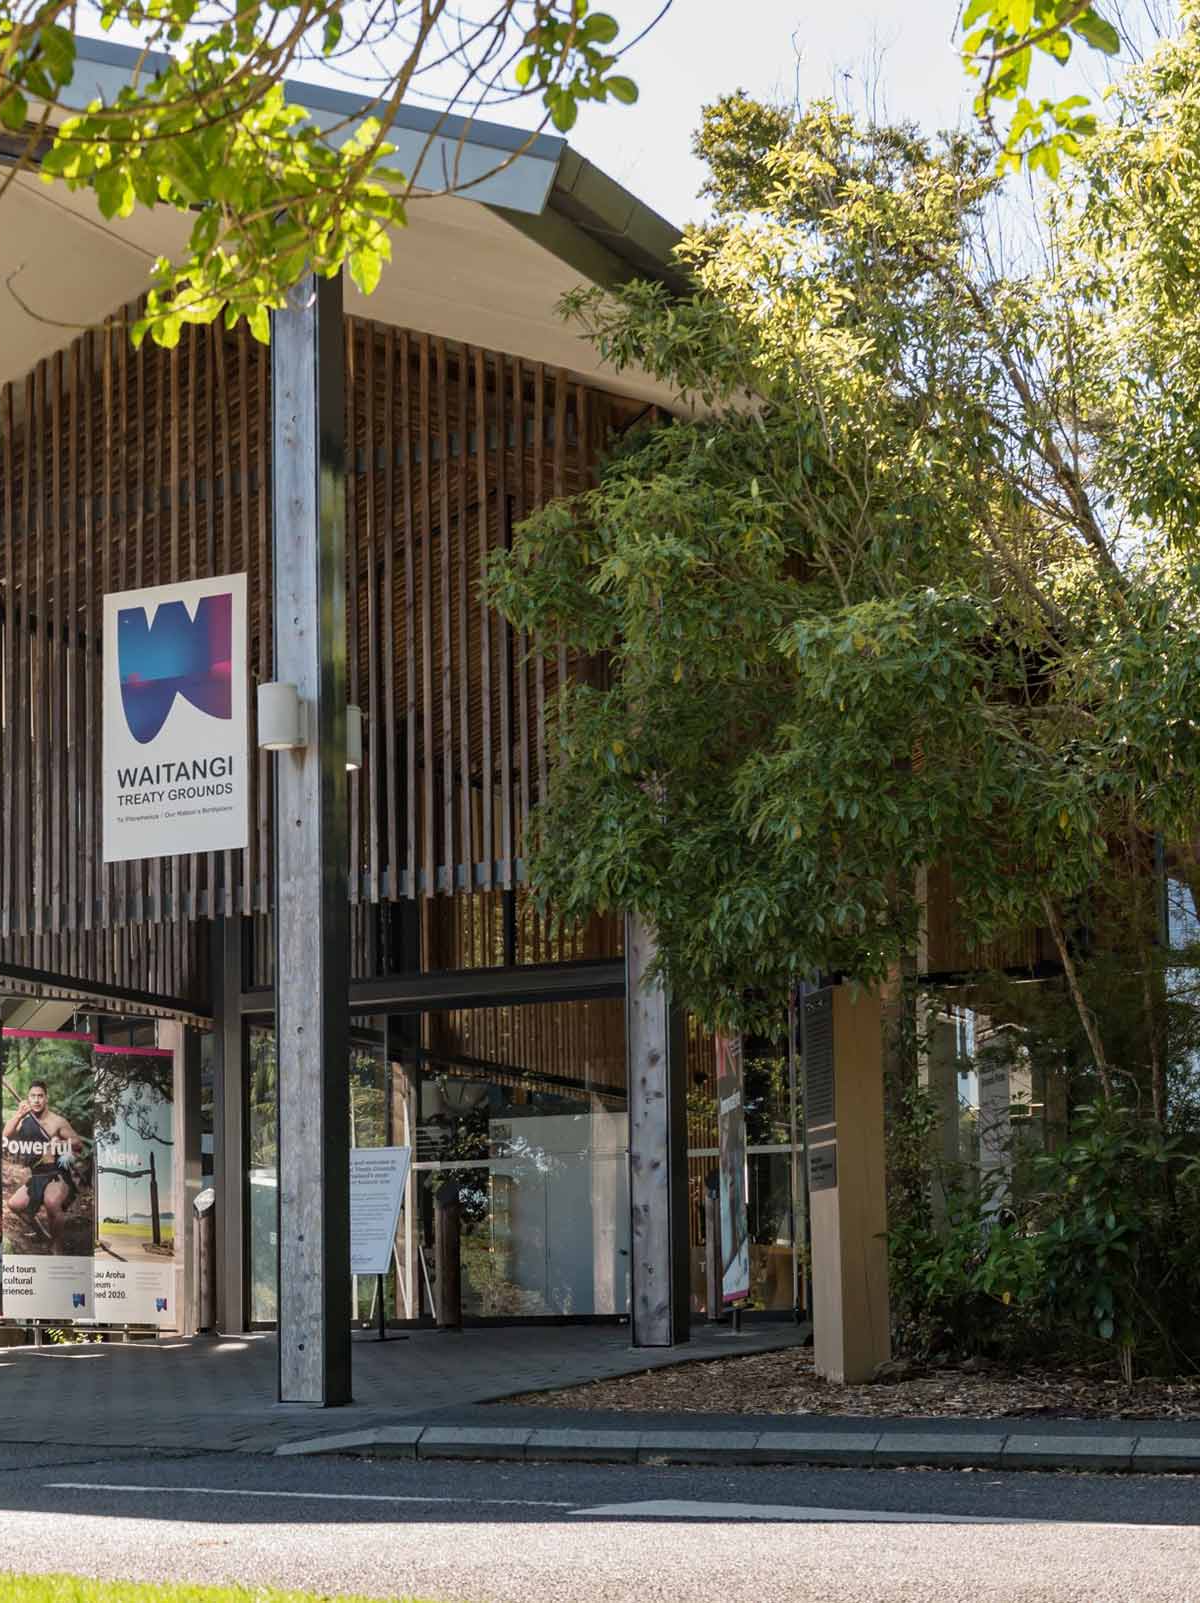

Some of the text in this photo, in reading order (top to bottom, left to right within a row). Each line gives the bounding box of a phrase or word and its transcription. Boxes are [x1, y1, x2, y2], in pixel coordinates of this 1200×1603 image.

[117, 755, 233, 789] WAITANGI
[116, 782, 233, 807] TREATY GROUNDS
[16, 1264, 37, 1273] tours
